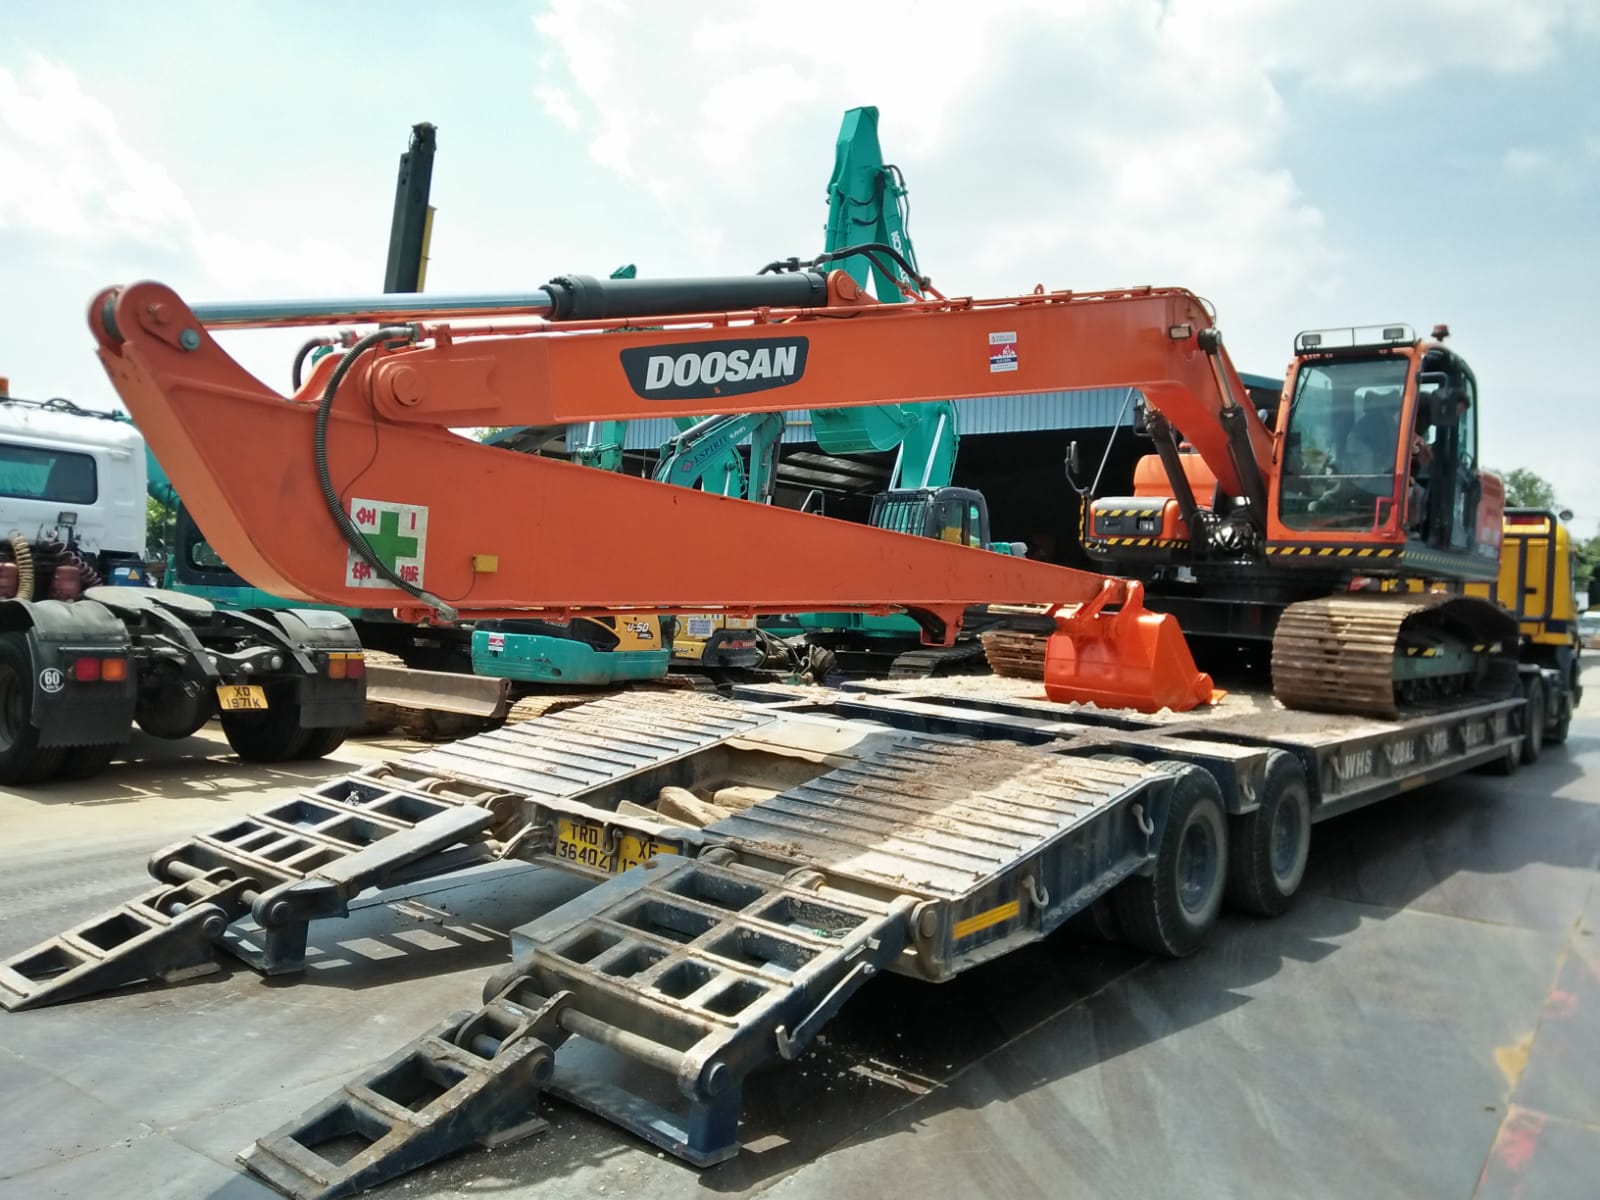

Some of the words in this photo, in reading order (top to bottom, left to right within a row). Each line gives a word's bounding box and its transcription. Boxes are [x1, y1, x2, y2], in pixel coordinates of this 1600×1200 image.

[645, 346, 798, 390] DOOSAN
[44, 671, 60, 685] 60
[233, 686, 251, 697] XD
[226, 697, 261, 708] 1971K
[1345, 749, 1373, 780] WHS
[570, 823, 598, 846] TRD
